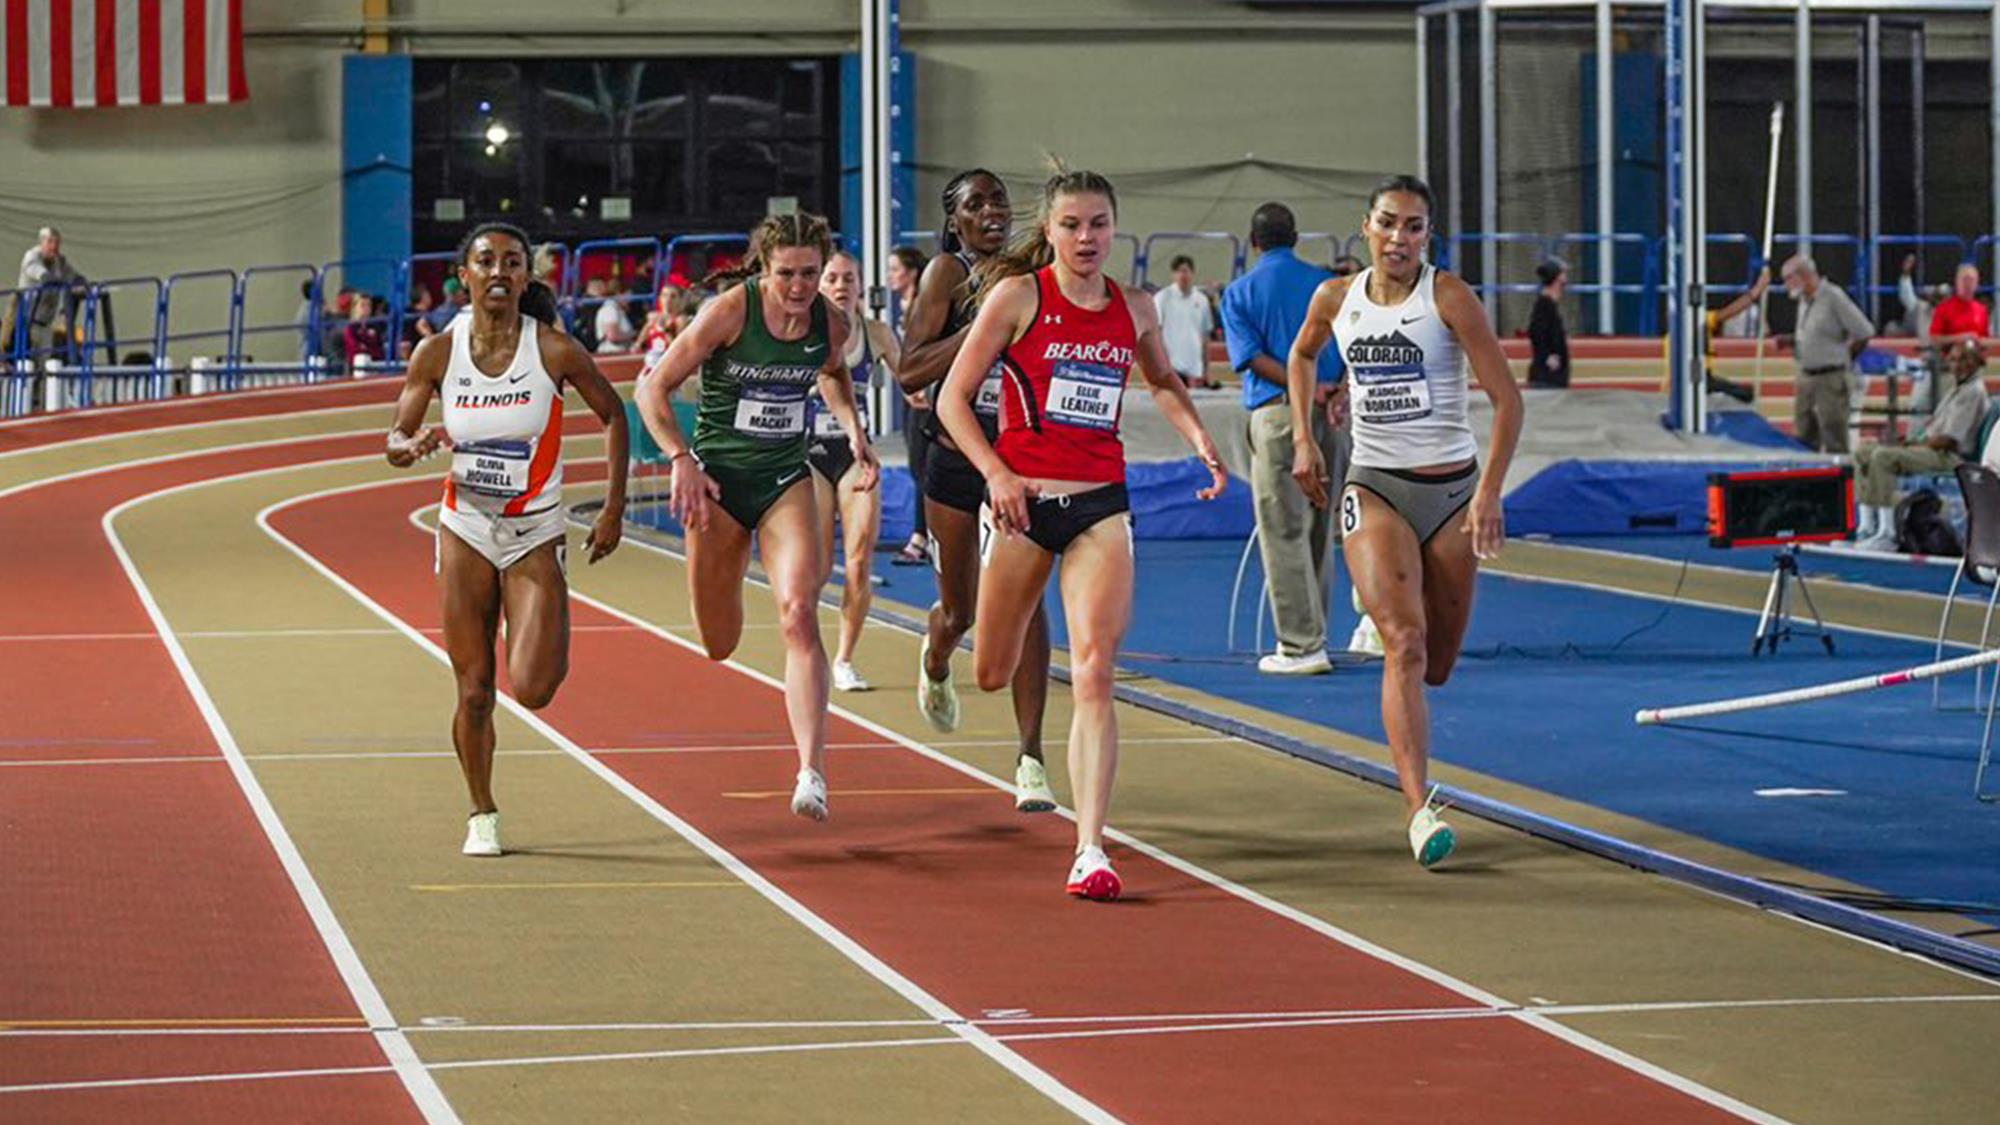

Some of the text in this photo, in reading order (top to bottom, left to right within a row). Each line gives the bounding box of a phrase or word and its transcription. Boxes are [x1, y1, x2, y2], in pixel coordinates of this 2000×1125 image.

[1044, 340, 1133, 366] BEARCATS
[1346, 346, 1424, 364] COLORADO
[455, 391, 532, 408] ILLINOIS
[1076, 385, 1101, 400] ELLIE
[1061, 396, 1110, 416] LEATHER
[465, 469, 512, 487] HOWELL
[1345, 495, 1356, 532] 8
